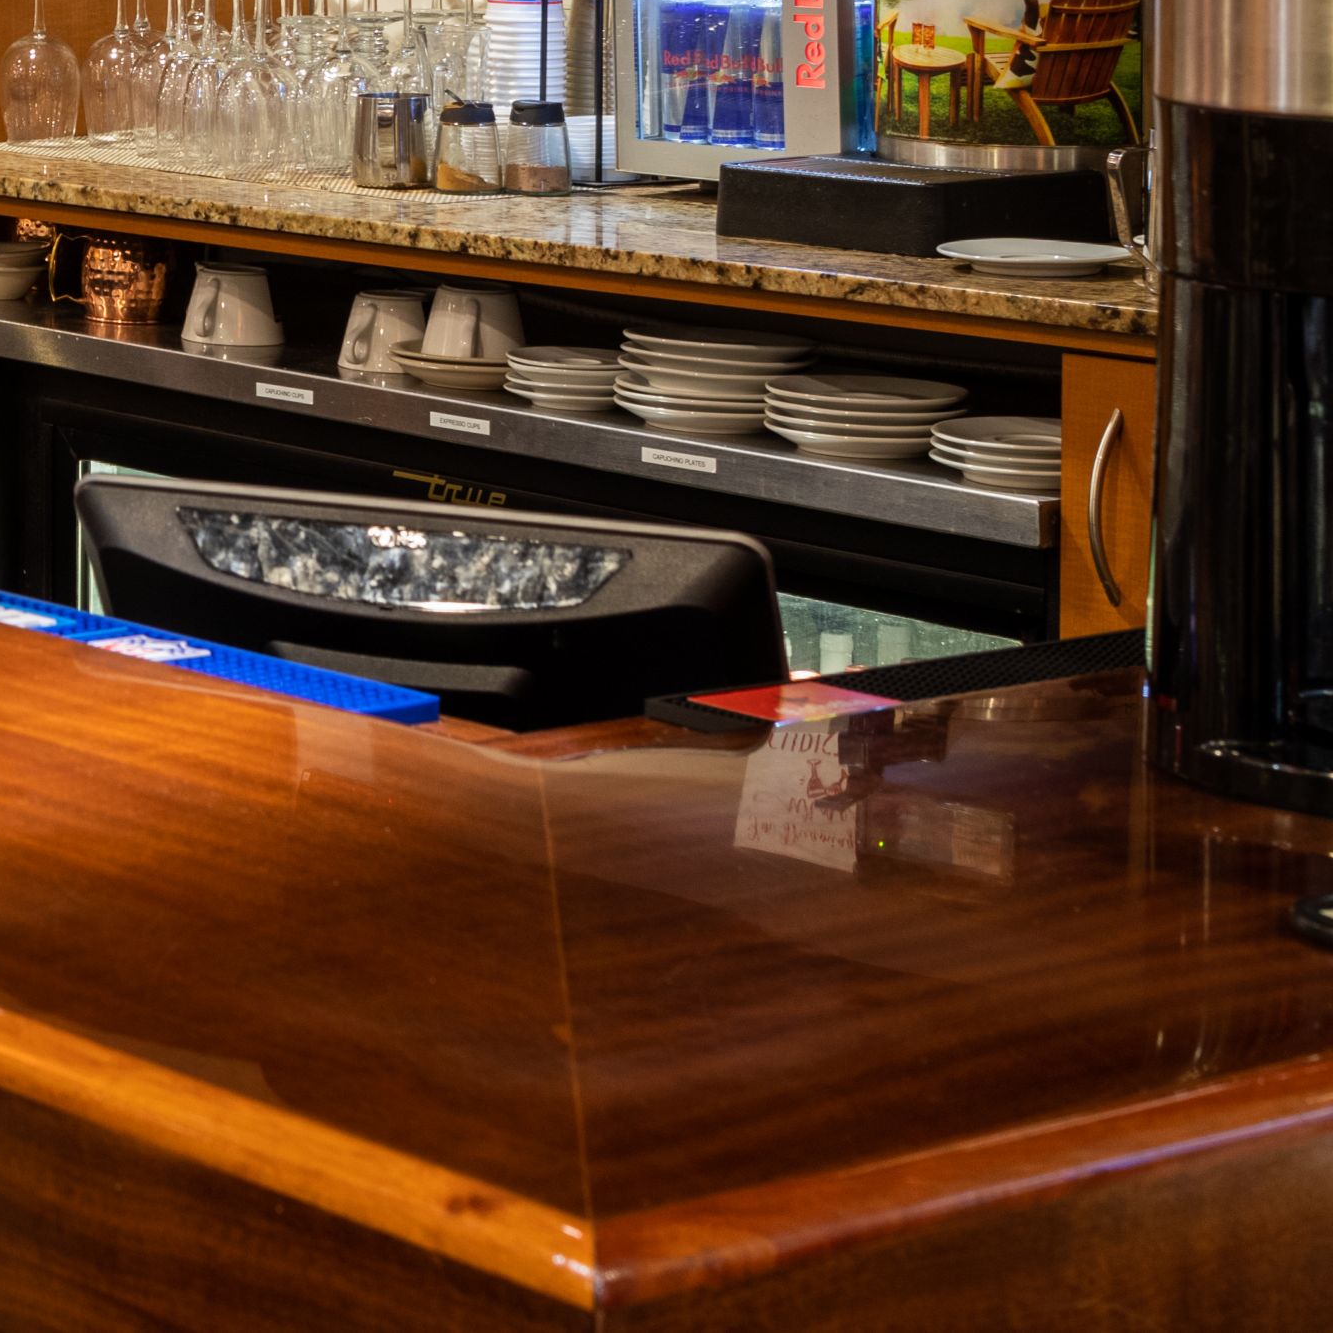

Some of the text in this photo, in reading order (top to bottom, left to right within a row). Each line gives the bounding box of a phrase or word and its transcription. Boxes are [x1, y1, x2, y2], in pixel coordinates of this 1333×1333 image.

[795, 13, 827, 90] Red
[684, 458, 706, 468] PLATES
[392, 470, 507, 506] true
